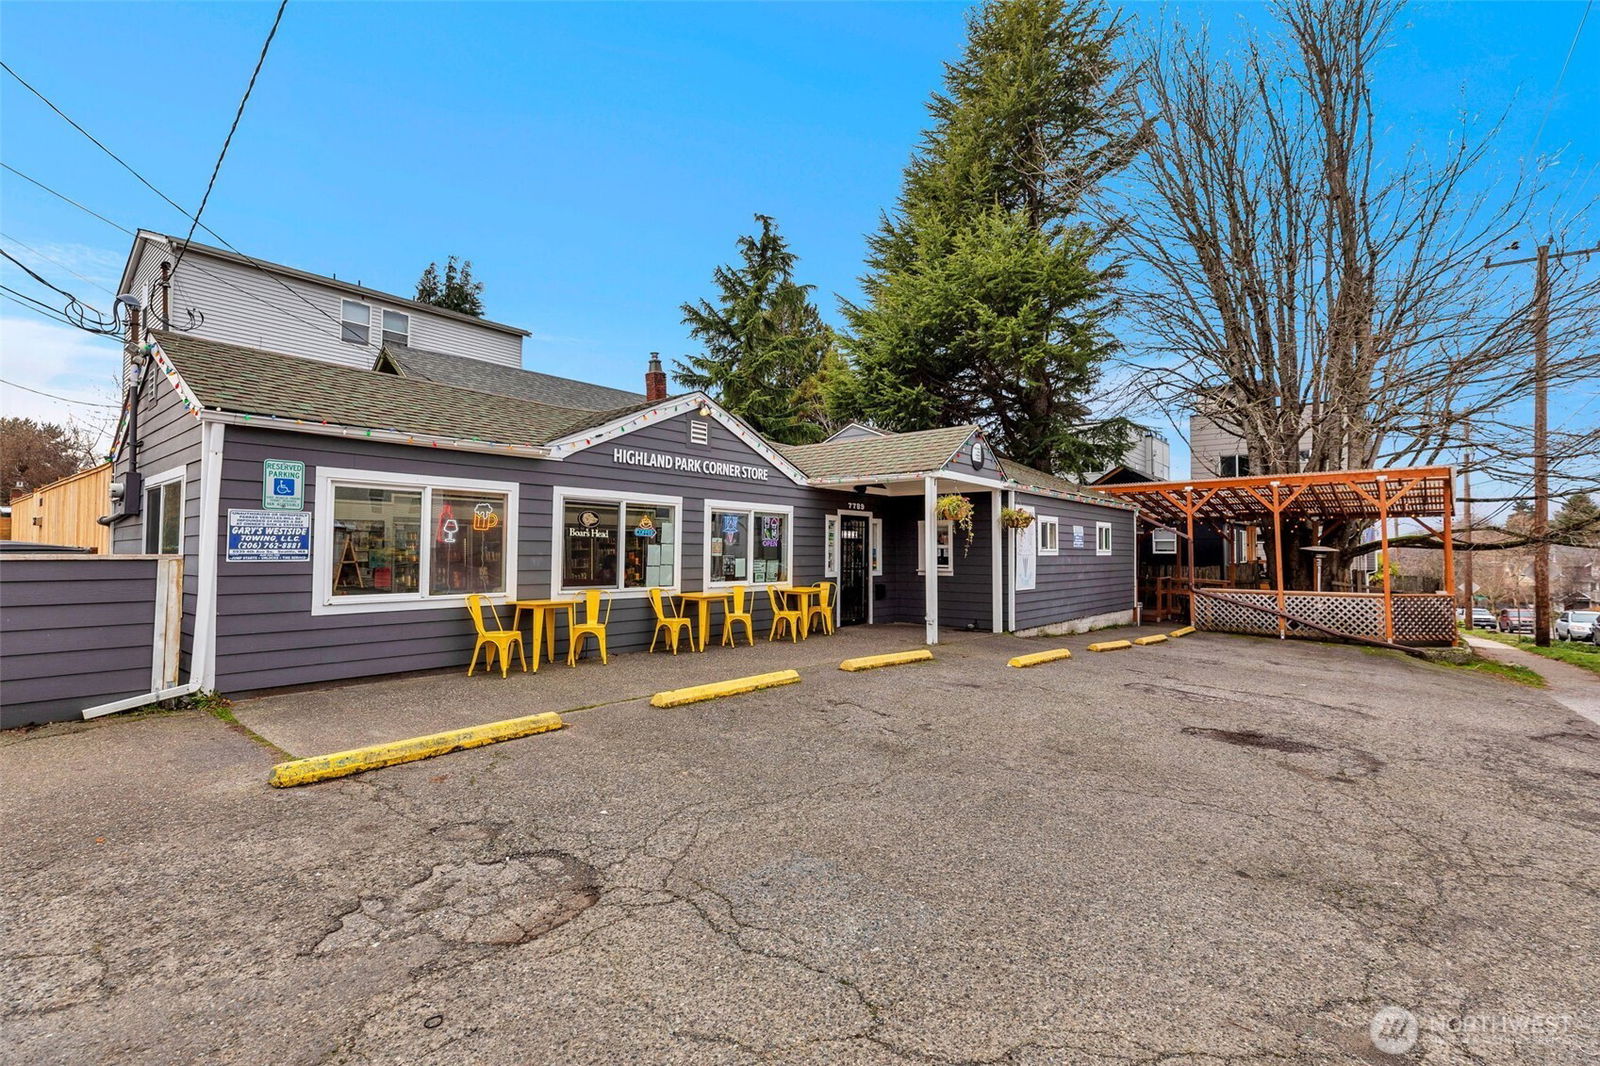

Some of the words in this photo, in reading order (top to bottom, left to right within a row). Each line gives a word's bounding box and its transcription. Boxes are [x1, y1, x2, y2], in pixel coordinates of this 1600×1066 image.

[267, 463, 301, 471] RESERVED
[614, 448, 673, 469] HIGHLAND
[675, 457, 701, 472] PARK
[703, 461, 740, 477] CORNER
[742, 465, 768, 480] STORE
[268, 470, 300, 479] PARKING
[569, 528, 590, 537] Boar's
[591, 528, 608, 538] Head
